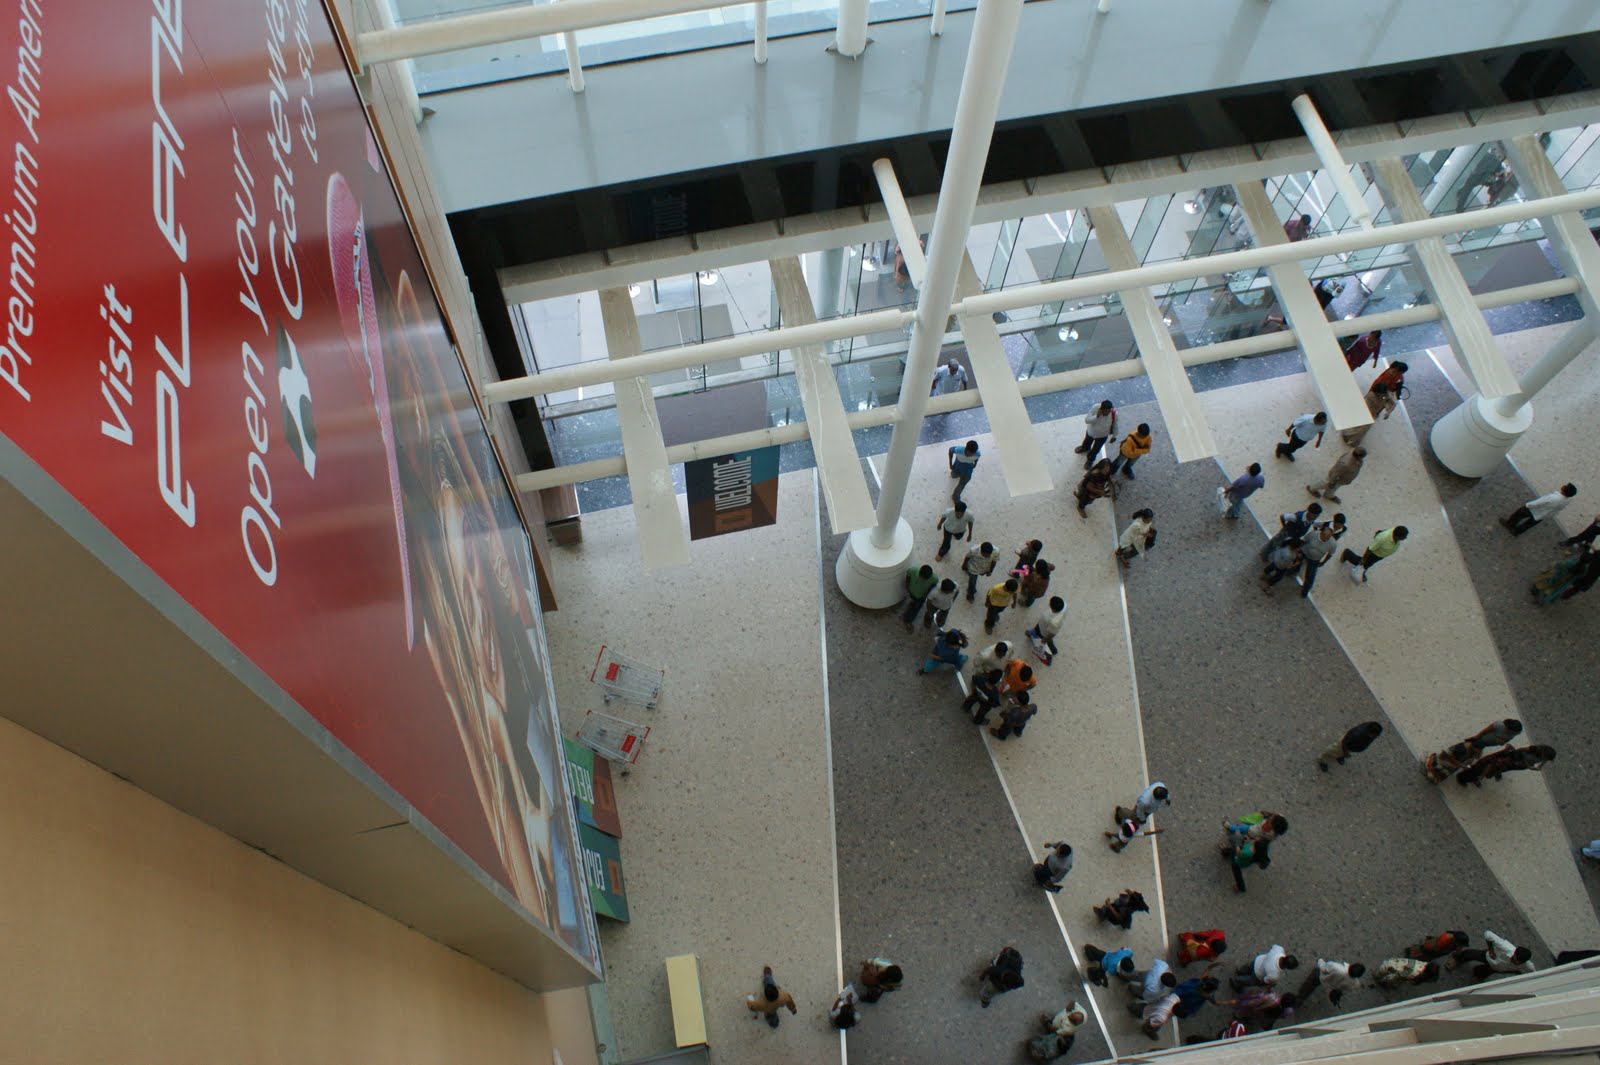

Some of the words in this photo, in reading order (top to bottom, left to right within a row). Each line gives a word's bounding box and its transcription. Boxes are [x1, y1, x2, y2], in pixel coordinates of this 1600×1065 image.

[300, 96, 318, 164] to
[0, 141, 39, 403] Premium
[232, 127, 269, 337] your
[99, 282, 134, 446] Visit
[240, 341, 281, 587] Open
[712, 455, 752, 512] WELCOME
